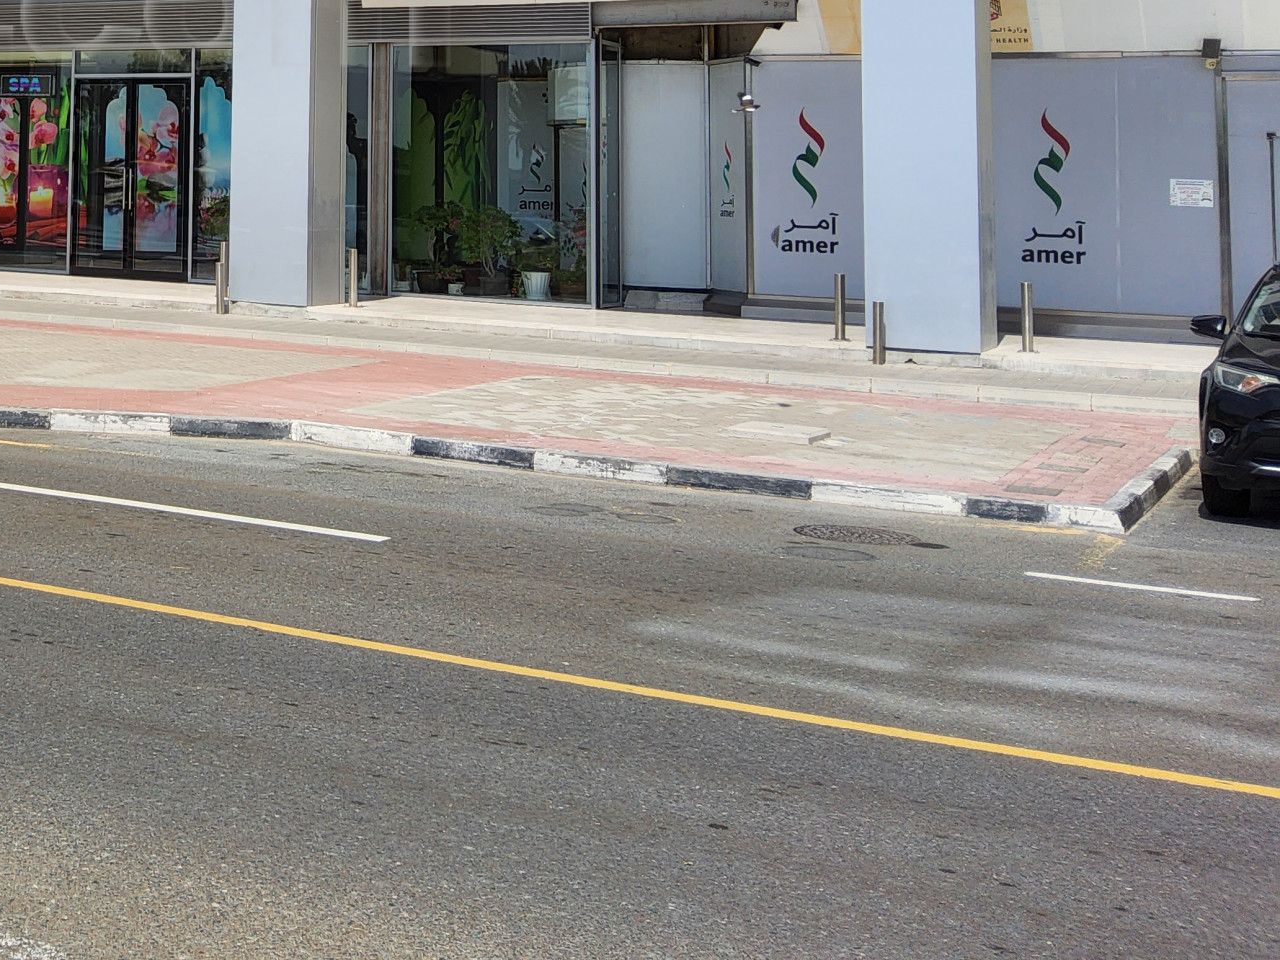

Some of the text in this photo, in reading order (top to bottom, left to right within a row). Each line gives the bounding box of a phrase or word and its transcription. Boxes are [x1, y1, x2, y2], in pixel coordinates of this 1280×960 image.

[9, 76, 42, 93] SPA
[720, 209, 735, 218] amer
[784, 212, 839, 235] آمر
[1024, 220, 1086, 245] آمر
[781, 239, 839, 254] amer
[1021, 248, 1087, 265] amer
